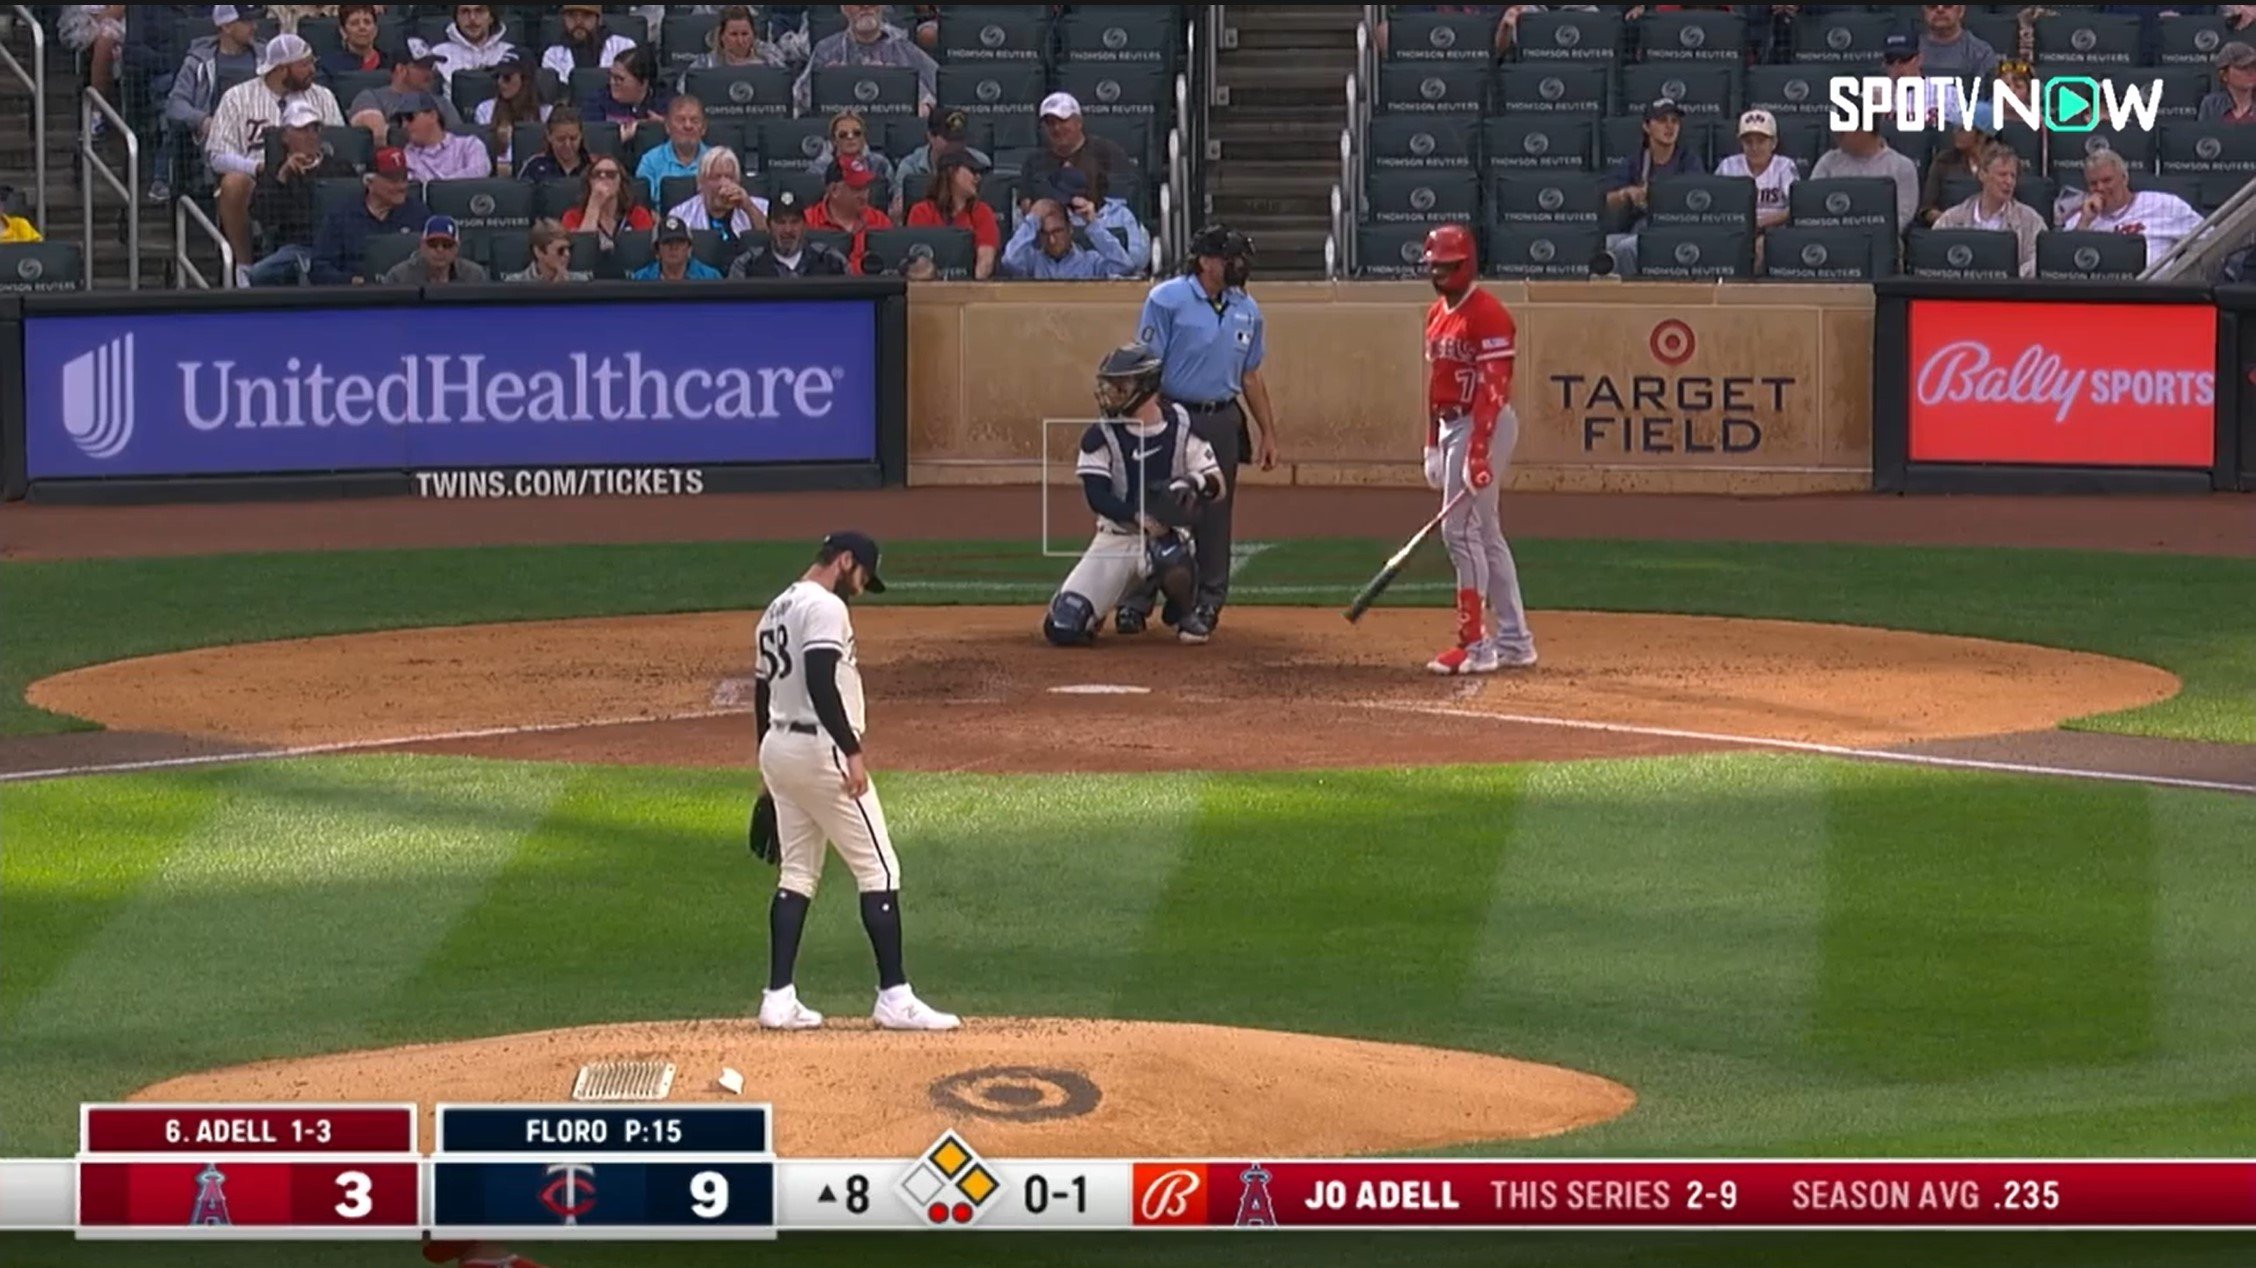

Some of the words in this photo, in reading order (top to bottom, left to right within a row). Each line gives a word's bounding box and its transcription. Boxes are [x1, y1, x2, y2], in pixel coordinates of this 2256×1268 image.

[1454, 368, 1476, 402] 7
[1550, 375, 1796, 411] TARGET
[1917, 341, 2085, 423] Bally
[2090, 370, 2215, 406] SPORTS
[1584, 417, 1762, 453] FIELD
[416, 469, 704, 498] TWINS.COM/TICKETS
